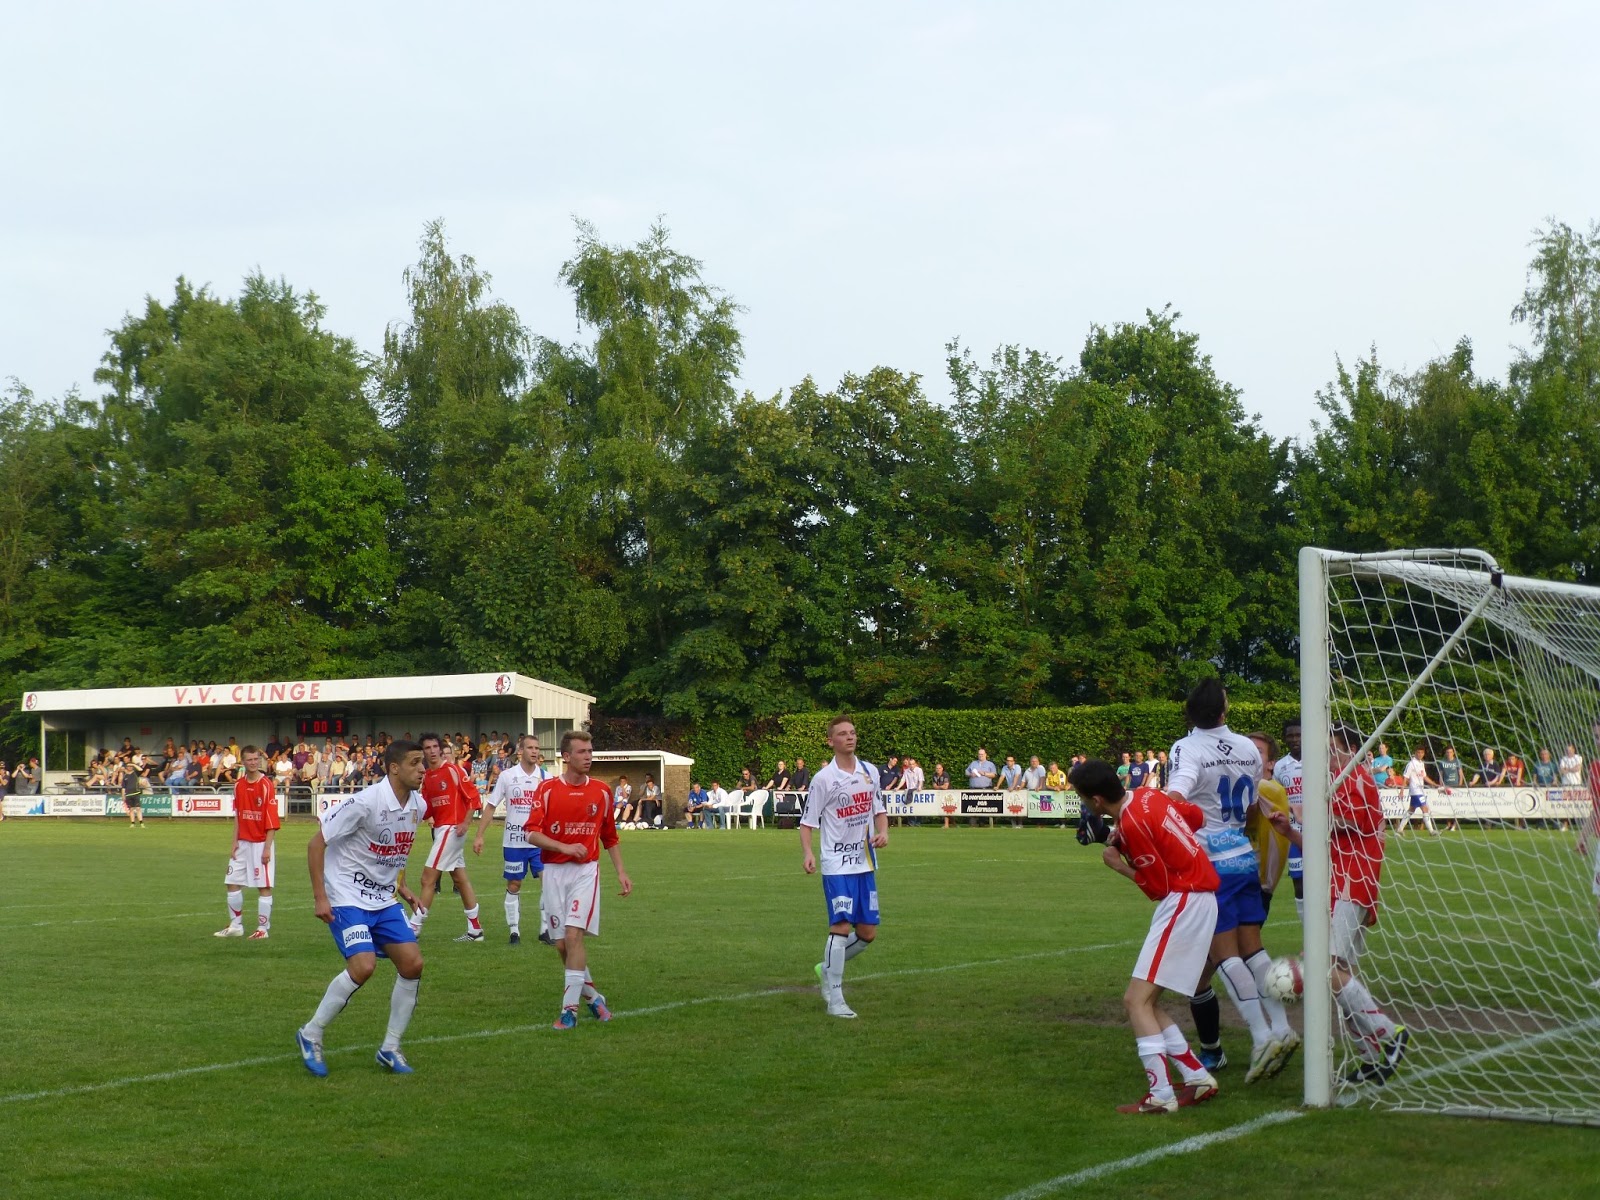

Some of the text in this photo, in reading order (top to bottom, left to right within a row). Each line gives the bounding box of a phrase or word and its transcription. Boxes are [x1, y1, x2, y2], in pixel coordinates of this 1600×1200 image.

[175, 683, 321, 704] V.V. CLINGE
[195, 800, 219, 808] BRACKE
[1217, 774, 1255, 823] 10
[354, 871, 396, 894] Remo
[571, 899, 579, 912] 3
